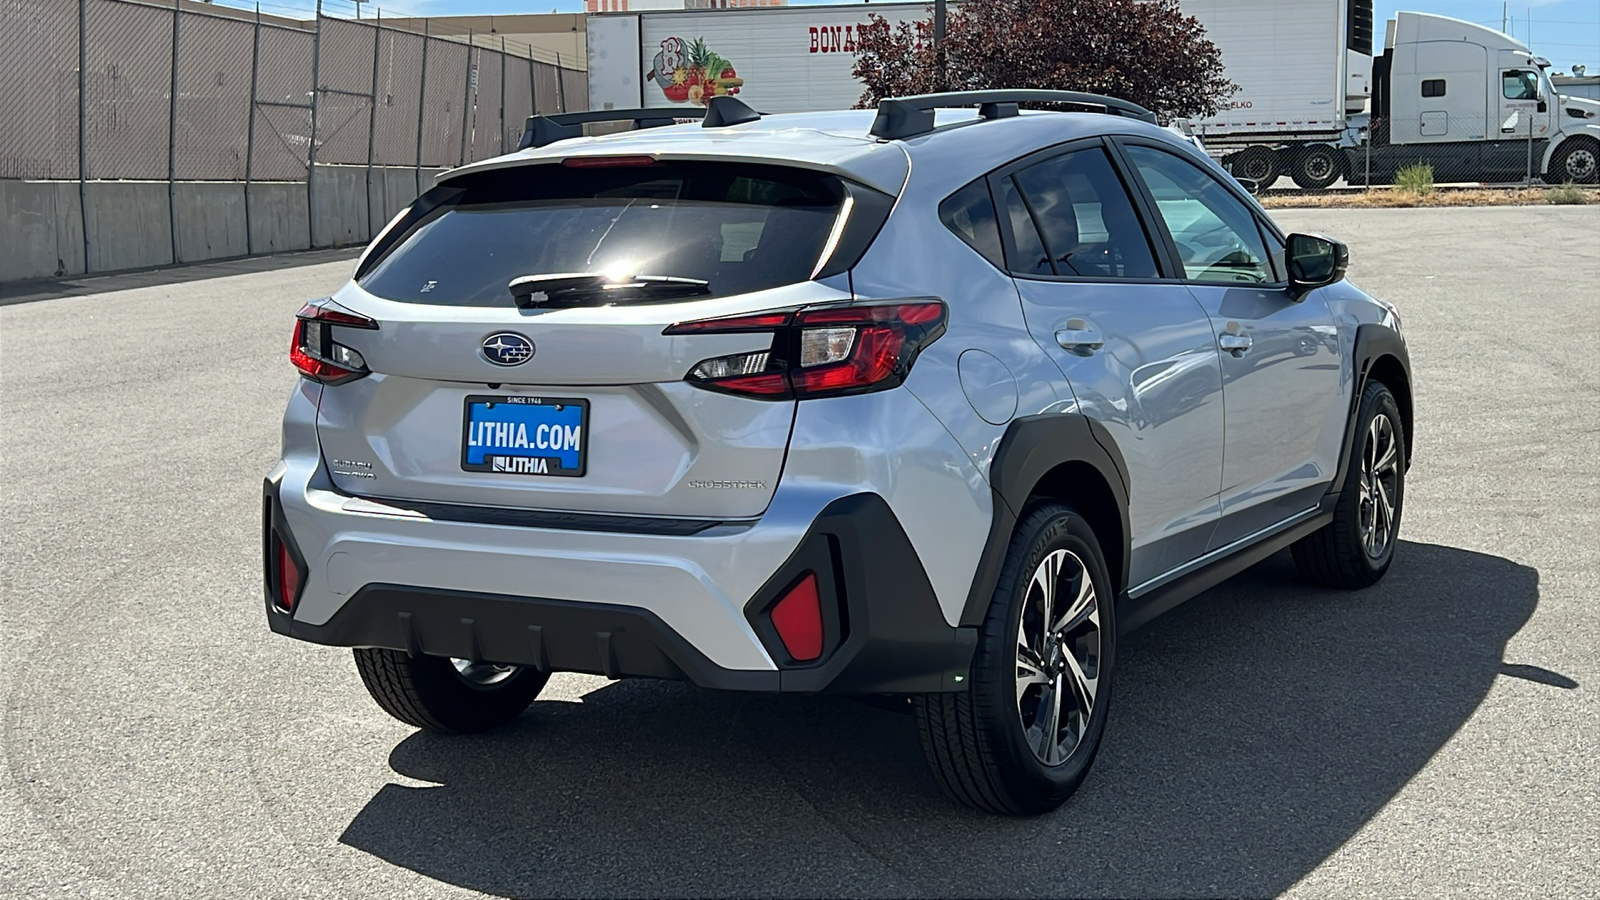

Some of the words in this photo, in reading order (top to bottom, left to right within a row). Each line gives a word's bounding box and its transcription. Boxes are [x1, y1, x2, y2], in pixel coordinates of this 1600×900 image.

[1230, 101, 1252, 109] ELKO
[468, 421, 580, 451] LITHIA.COM
[333, 459, 372, 470] SUBARU
[505, 456, 548, 474] LITHIA
[687, 480, 767, 489] CROSSTREK
[1020, 525, 1058, 589] YOKOHAMA
